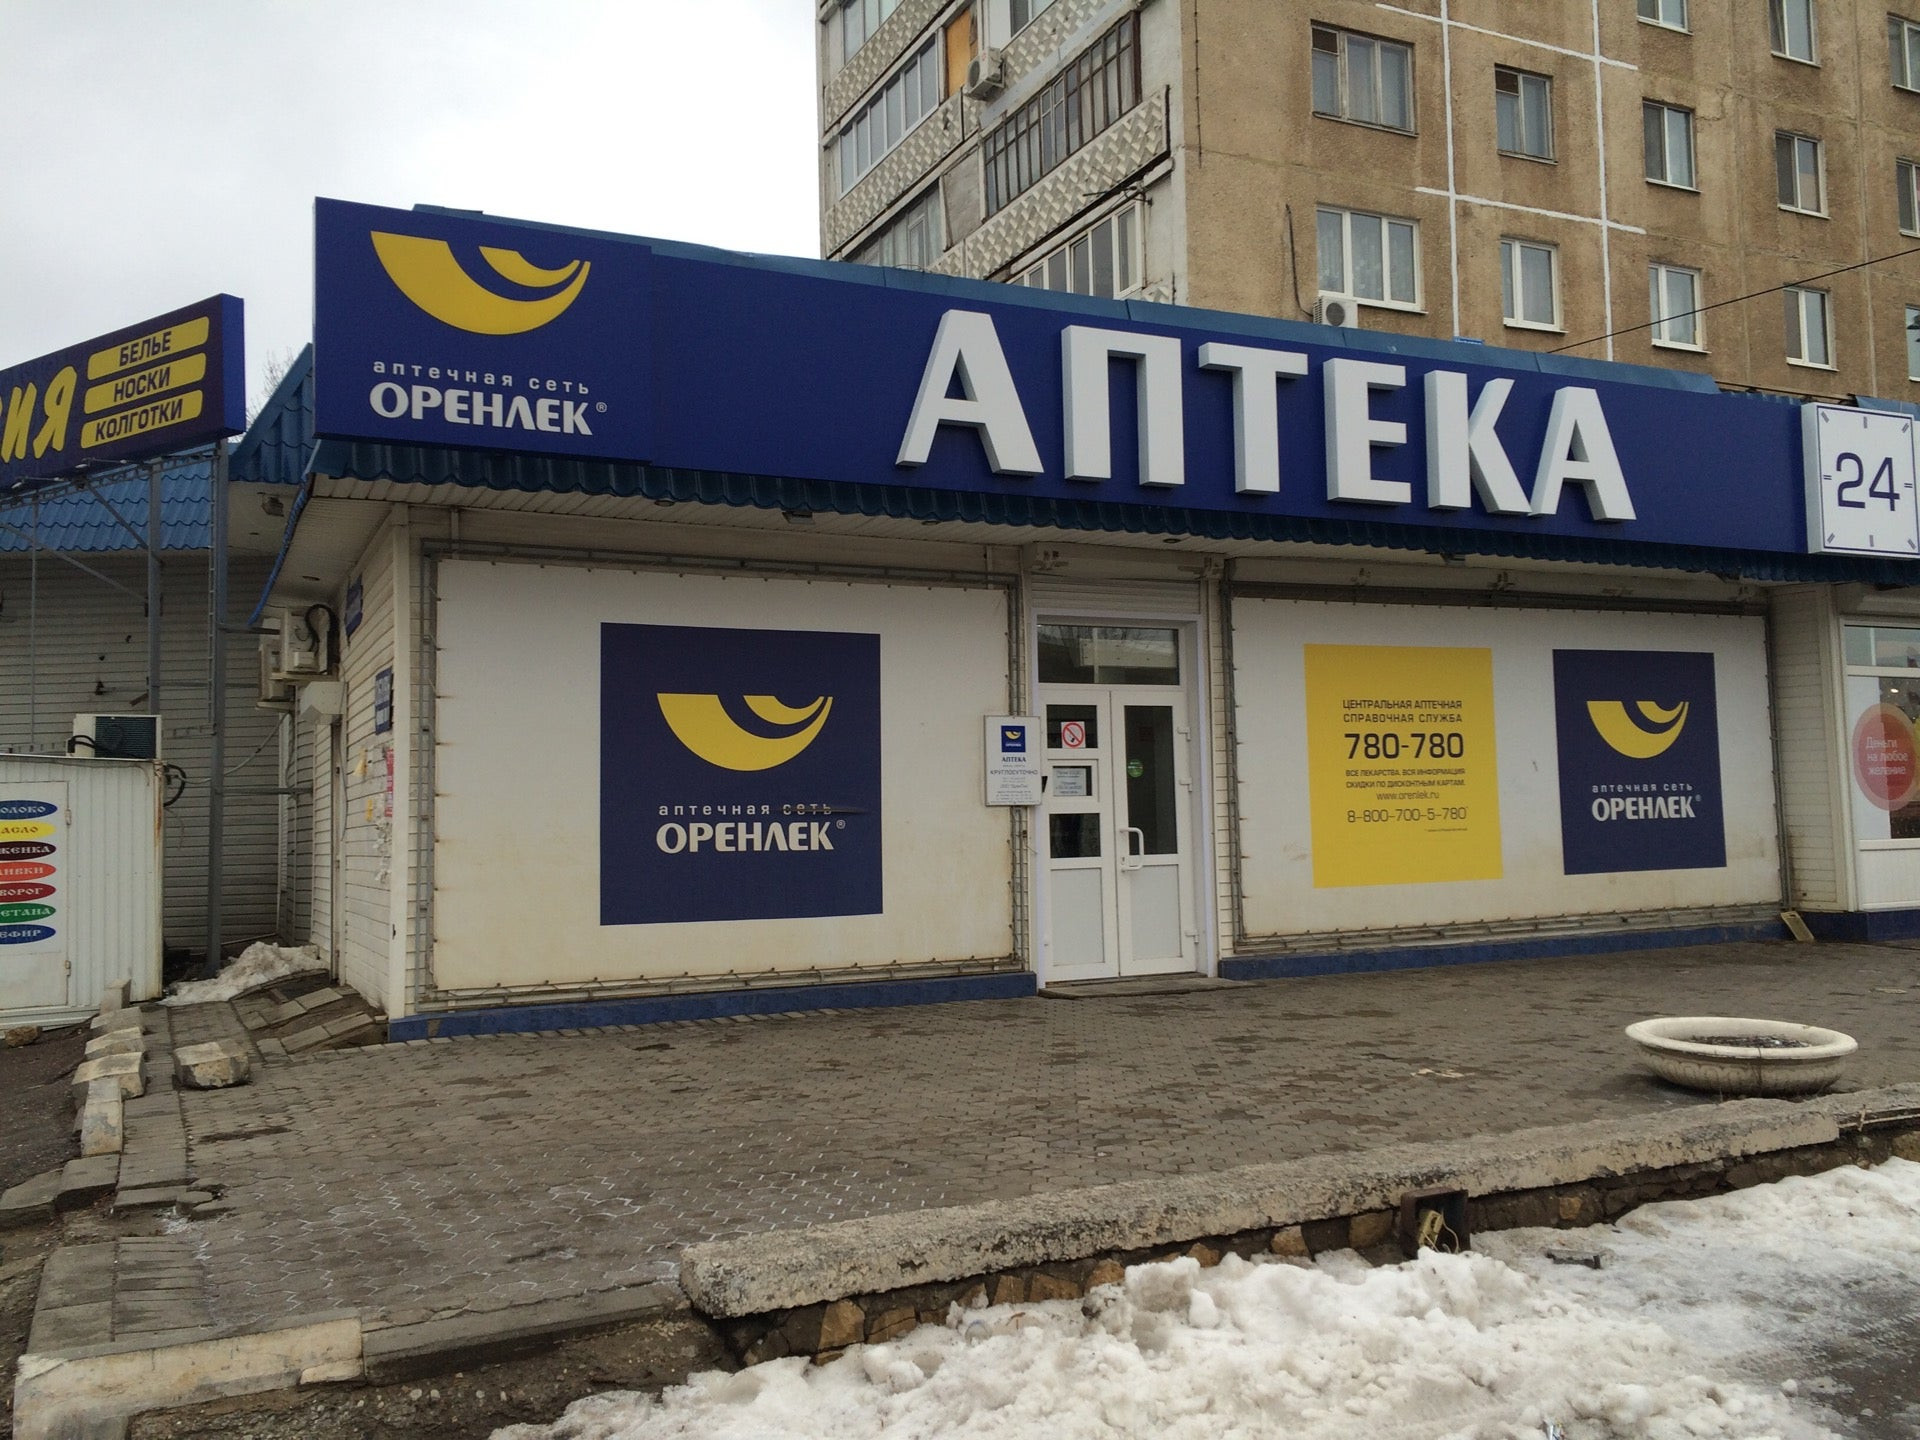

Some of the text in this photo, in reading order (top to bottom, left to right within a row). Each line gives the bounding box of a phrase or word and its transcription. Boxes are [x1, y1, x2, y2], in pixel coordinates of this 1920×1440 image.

[119, 331, 172, 367] БЕЛЬЕ
[373, 361, 590, 395] аптечная сеть
[113, 366, 171, 402] НОСКИ
[0, 365, 78, 464] ИЯ
[895, 308, 1638, 522] АПТЕКА
[95, 399, 183, 441] КОЛГОТКИ
[1835, 452, 1900, 512] 24
[1343, 700, 1463, 710] ЦЕНТРАЛЬНАЯ АПТЕЧНАЯ
[1343, 713, 1463, 723] СПРАВОЧНАЯ СЛУЖБА
[1344, 732, 1464, 759] 780-780
[1345, 769, 1359, 777] ВСЕ
[1591, 783, 1693, 793] аптечная сеть
[0, 806, 46, 814] ОЛОКО
[658, 804, 770, 816] аптечная
[0, 826, 39, 835] АСЛО
[0, 866, 44, 876] ИВКИ
[0, 887, 43, 897] ВОРОГ
[0, 907, 51, 917] ЕТАНА
[0, 929, 41, 938] ЕФИР
